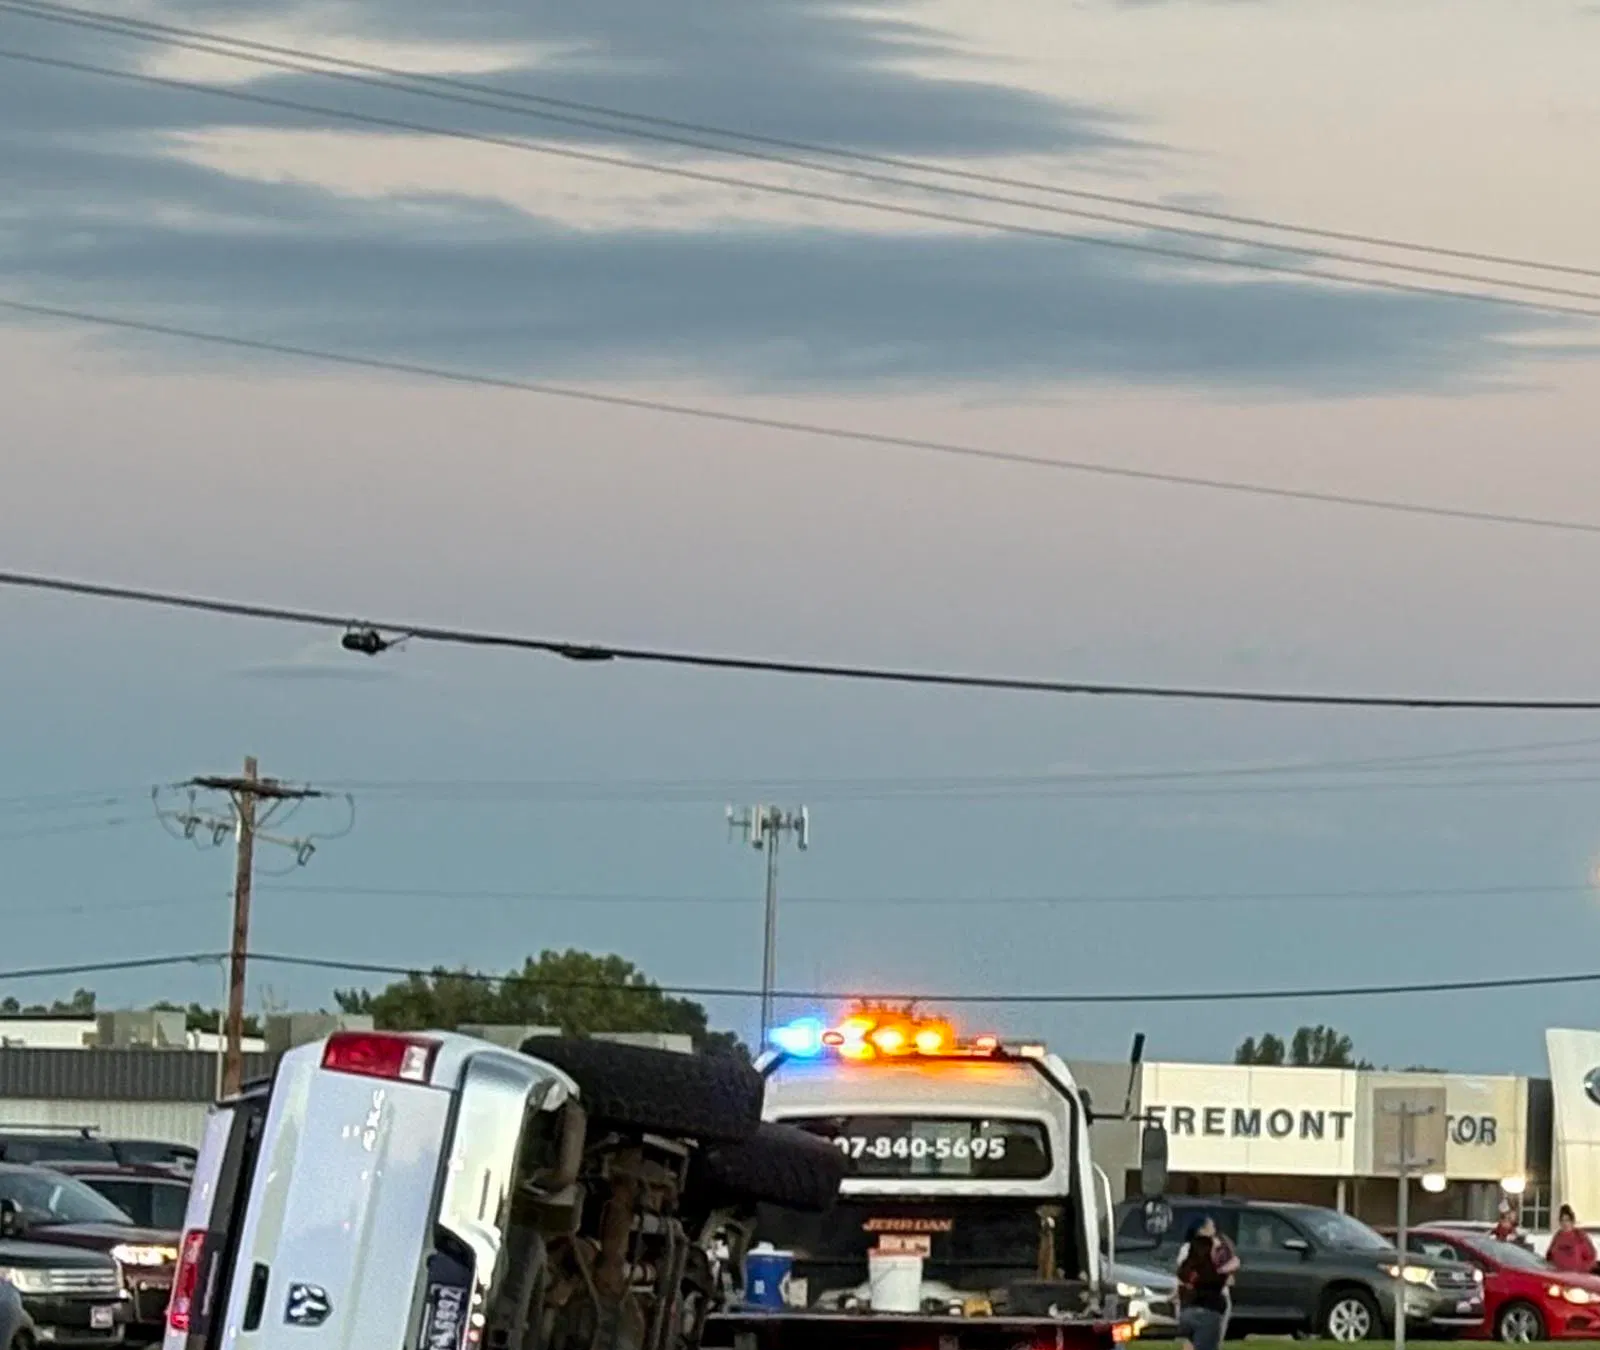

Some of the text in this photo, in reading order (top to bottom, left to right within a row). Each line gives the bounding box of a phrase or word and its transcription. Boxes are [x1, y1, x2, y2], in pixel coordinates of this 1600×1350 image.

[1144, 1105, 1497, 1144] FREMONT TOR
[833, 1136, 1006, 1160] 07-840-5695
